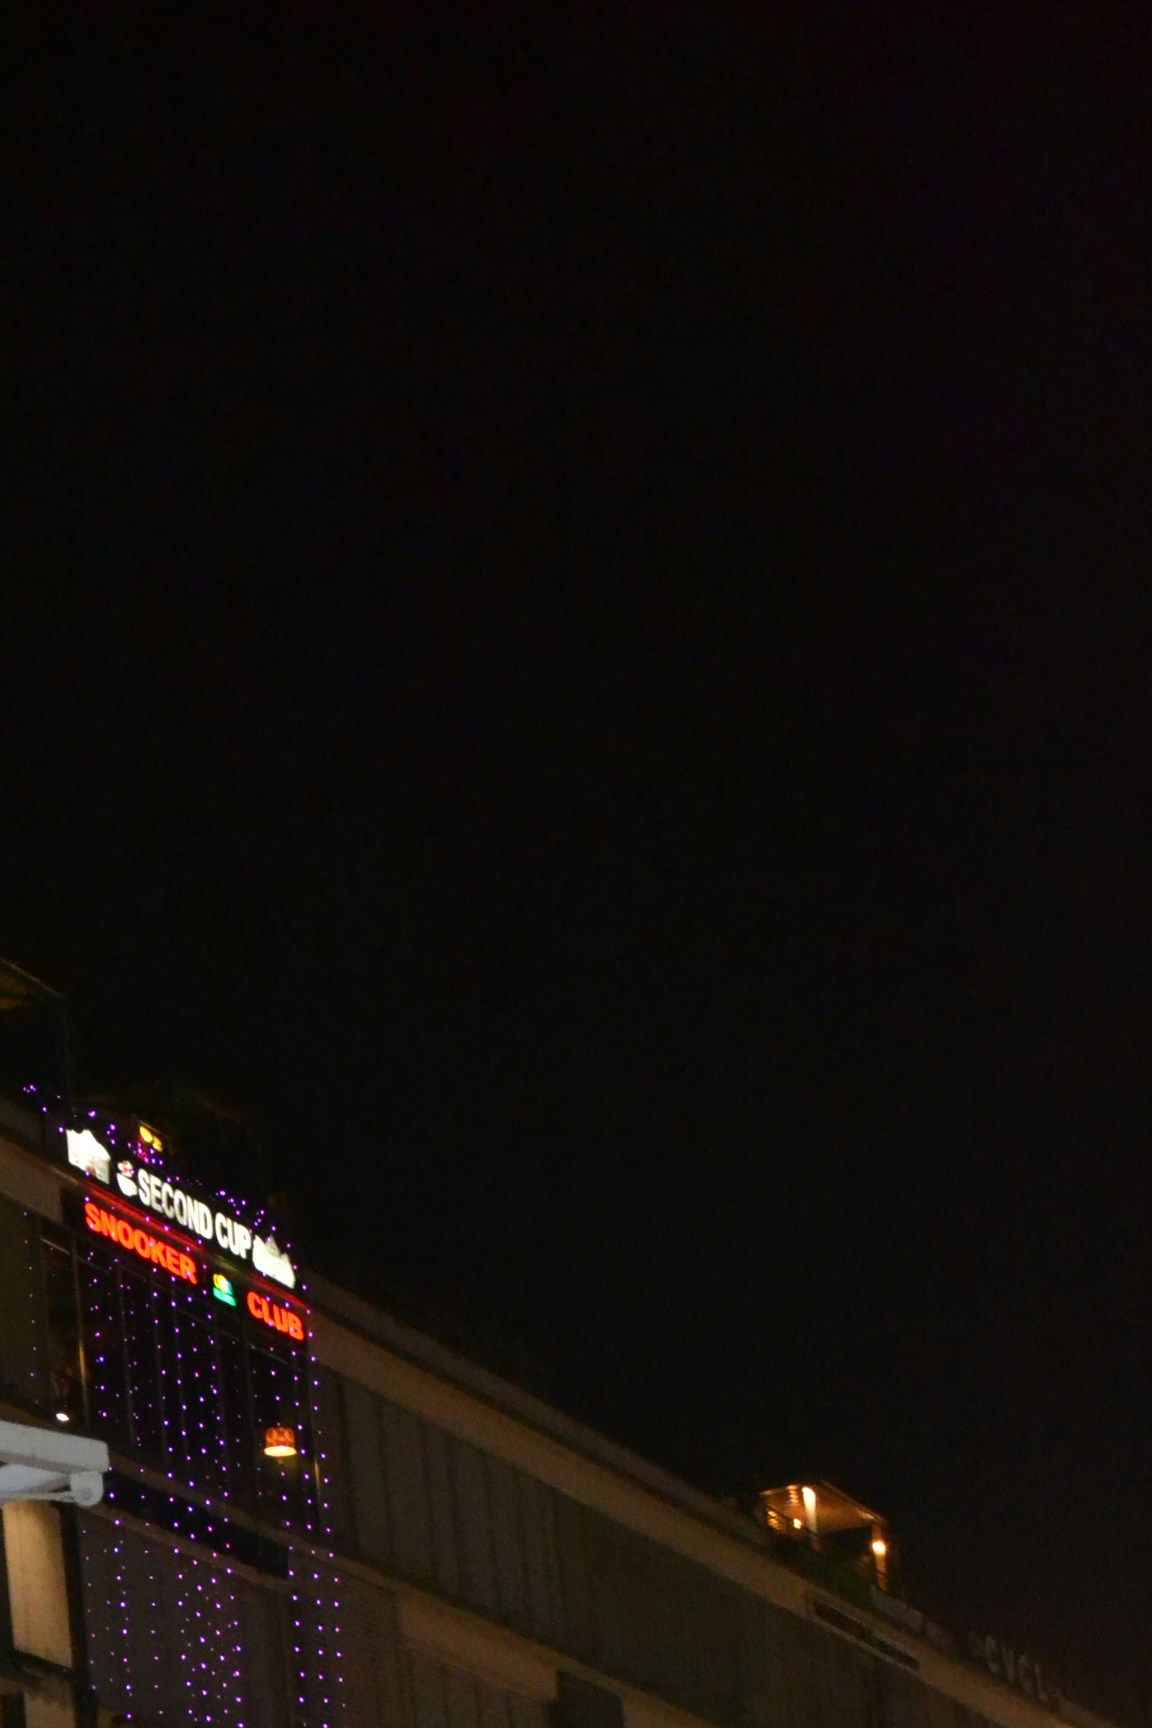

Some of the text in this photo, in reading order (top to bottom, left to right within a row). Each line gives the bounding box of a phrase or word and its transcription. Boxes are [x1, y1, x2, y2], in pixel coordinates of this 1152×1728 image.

[84, 1202, 199, 1285] SNOOKER
[137, 1168, 252, 1260] SECOND CUP
[246, 1290, 305, 1341] CLUB
